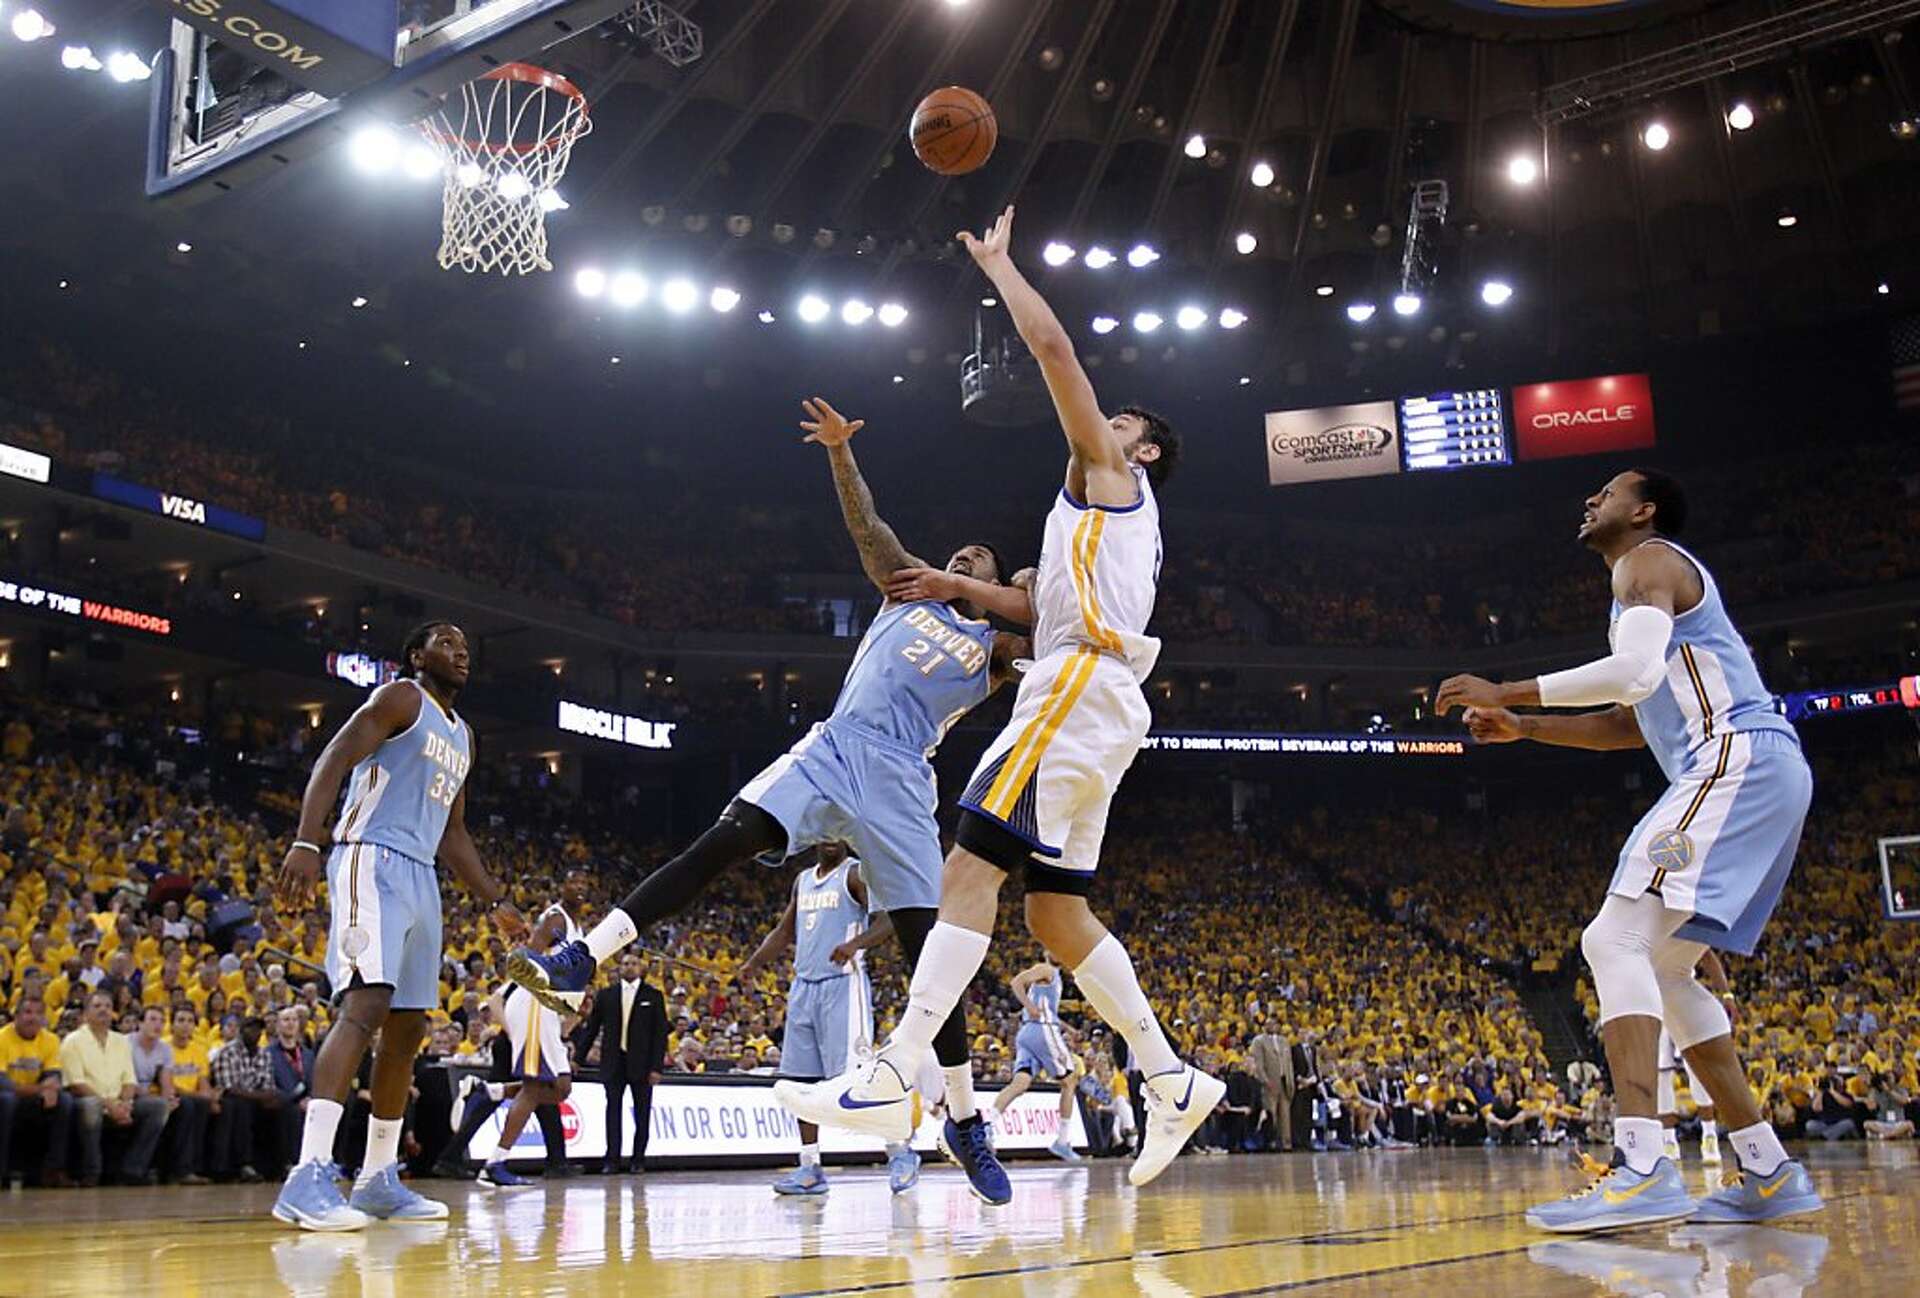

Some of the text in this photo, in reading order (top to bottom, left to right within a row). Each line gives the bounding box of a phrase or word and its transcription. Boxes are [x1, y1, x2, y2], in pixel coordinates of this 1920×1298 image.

[1532, 405, 1635, 429] ORACLE
[1293, 441, 1376, 458] SPORTSNET
[160, 495, 205, 524] VISA
[19, 587, 46, 605] OF
[47, 592, 82, 615] THE
[83, 600, 170, 634] WARRIORS
[901, 639, 946, 675] 21
[902, 606, 987, 675] DENVER
[424, 731, 469, 782] DENVE
[1161, 737, 1180, 749] TO
[1182, 738, 1223, 750] DRINK
[1223, 738, 1280, 751] PROTEIN
[1281, 739, 1349, 752] BEVERAGE
[1350, 740, 1369, 753] OF
[1370, 740, 1395, 753] THE
[1397, 741, 1464, 754] WARRIORS
[430, 772, 458, 807] 35
[682, 1106, 715, 1140] OR
[719, 1106, 748, 1140] GO
[753, 1106, 800, 1140] HOM
[1003, 1107, 1024, 1136] GO
